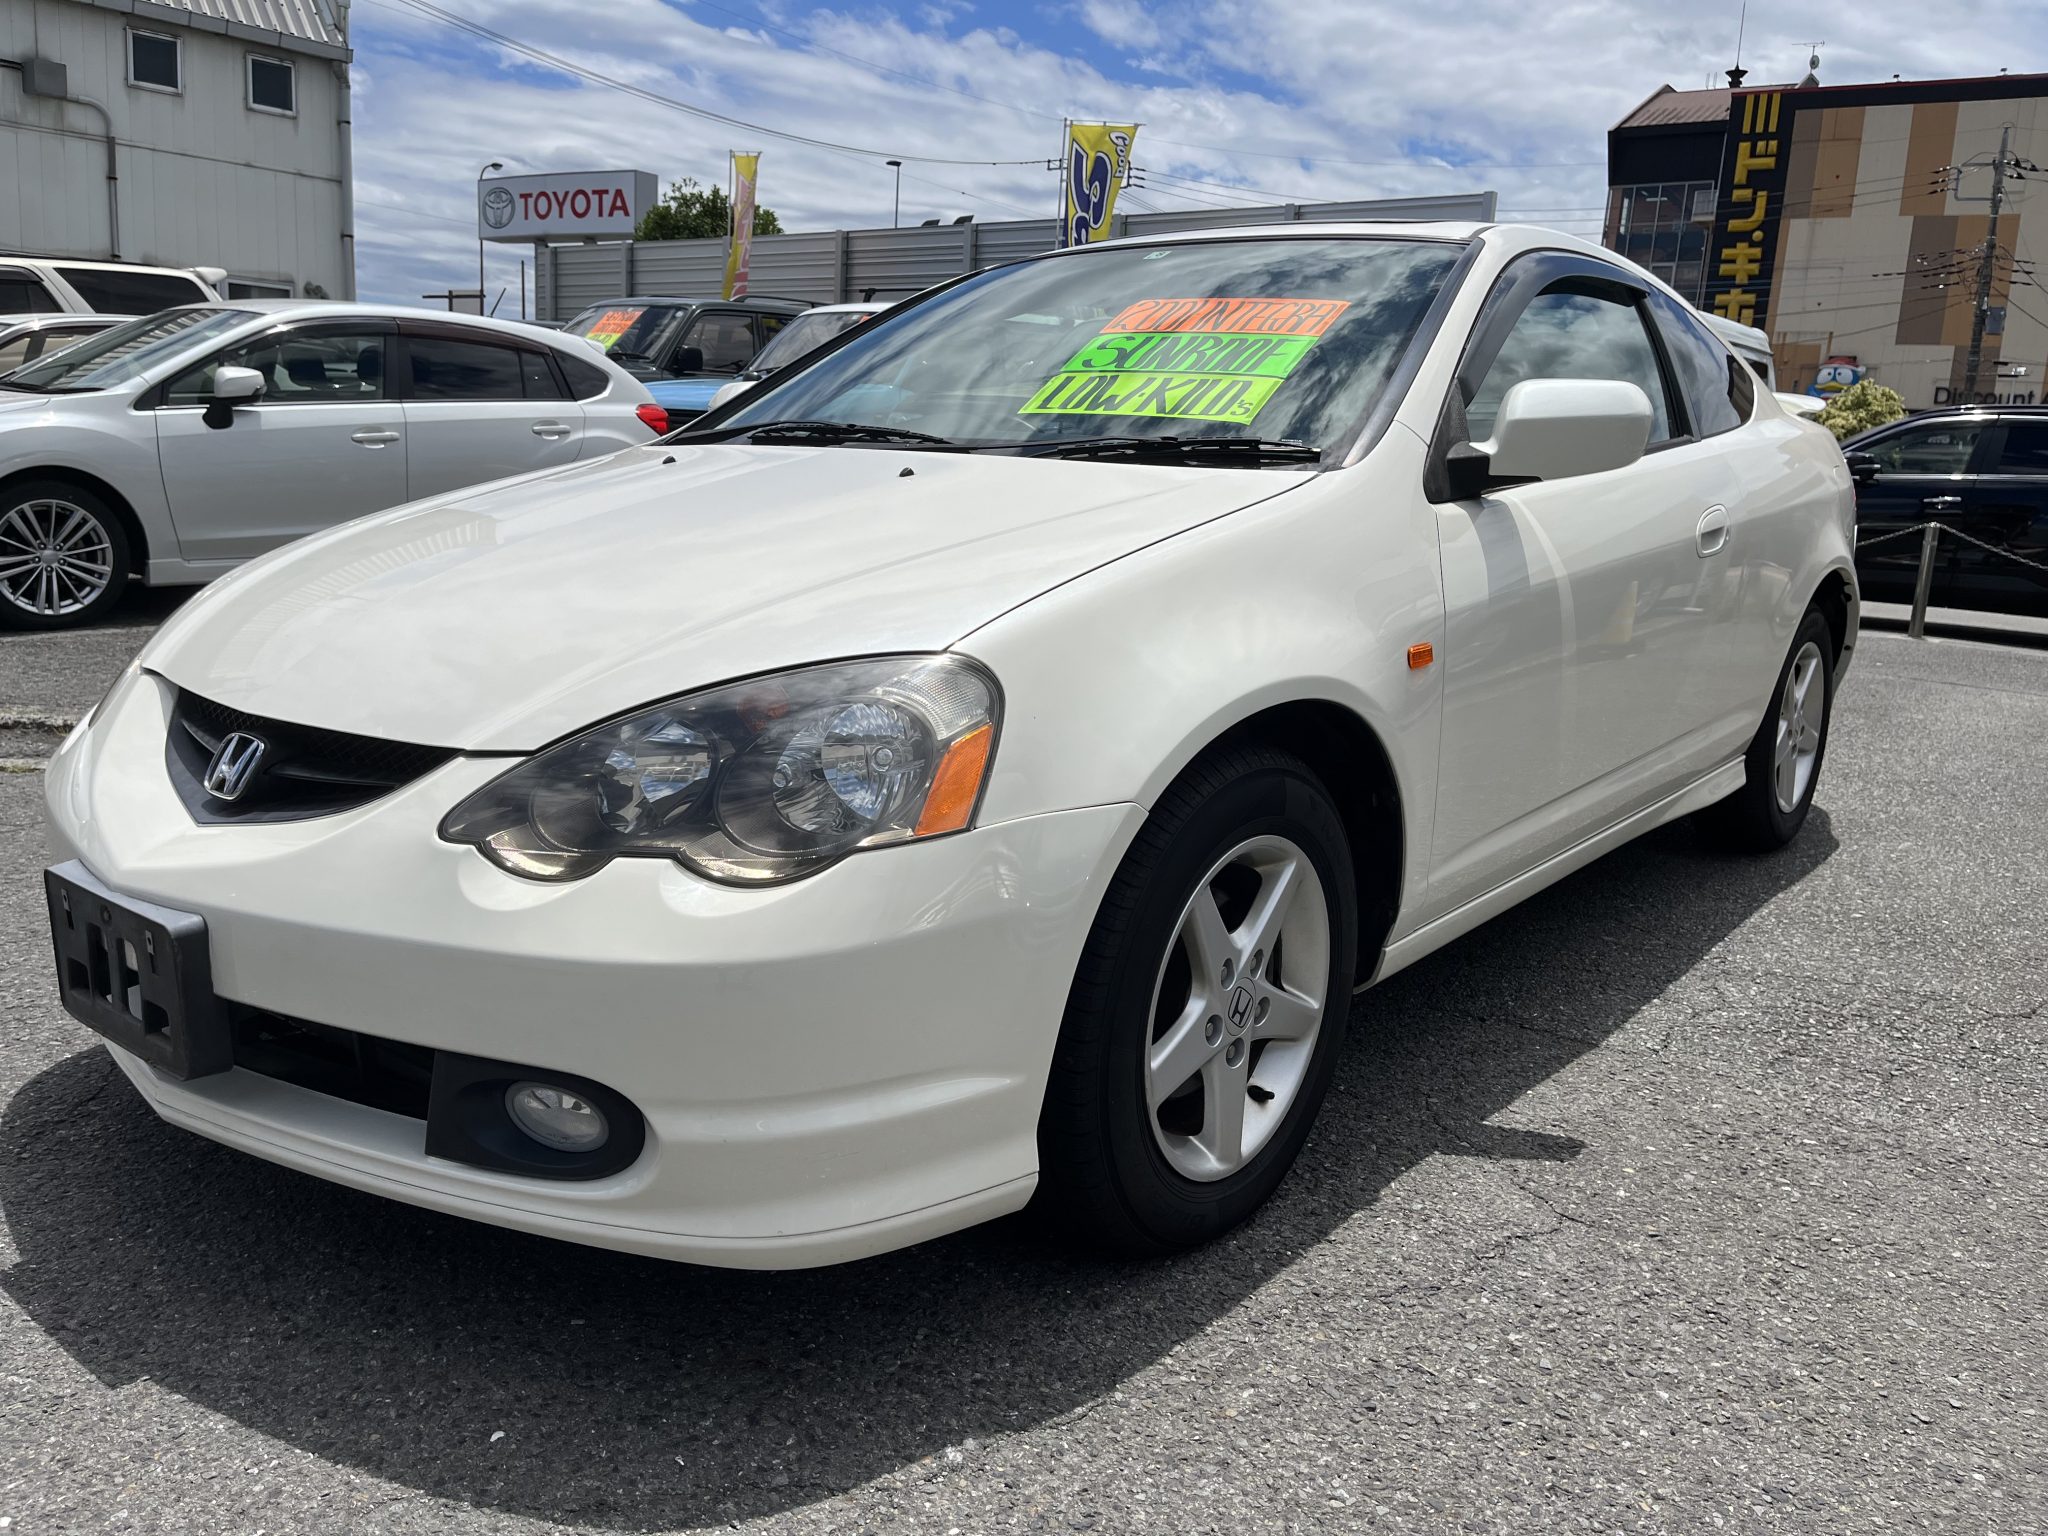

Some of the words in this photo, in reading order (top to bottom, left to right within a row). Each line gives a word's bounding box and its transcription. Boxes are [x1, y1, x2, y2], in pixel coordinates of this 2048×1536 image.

[519, 188, 630, 220] TOYOTA
[1190, 300, 1339, 333] INTEGRA
[1081, 335, 1297, 373] SUNROOF
